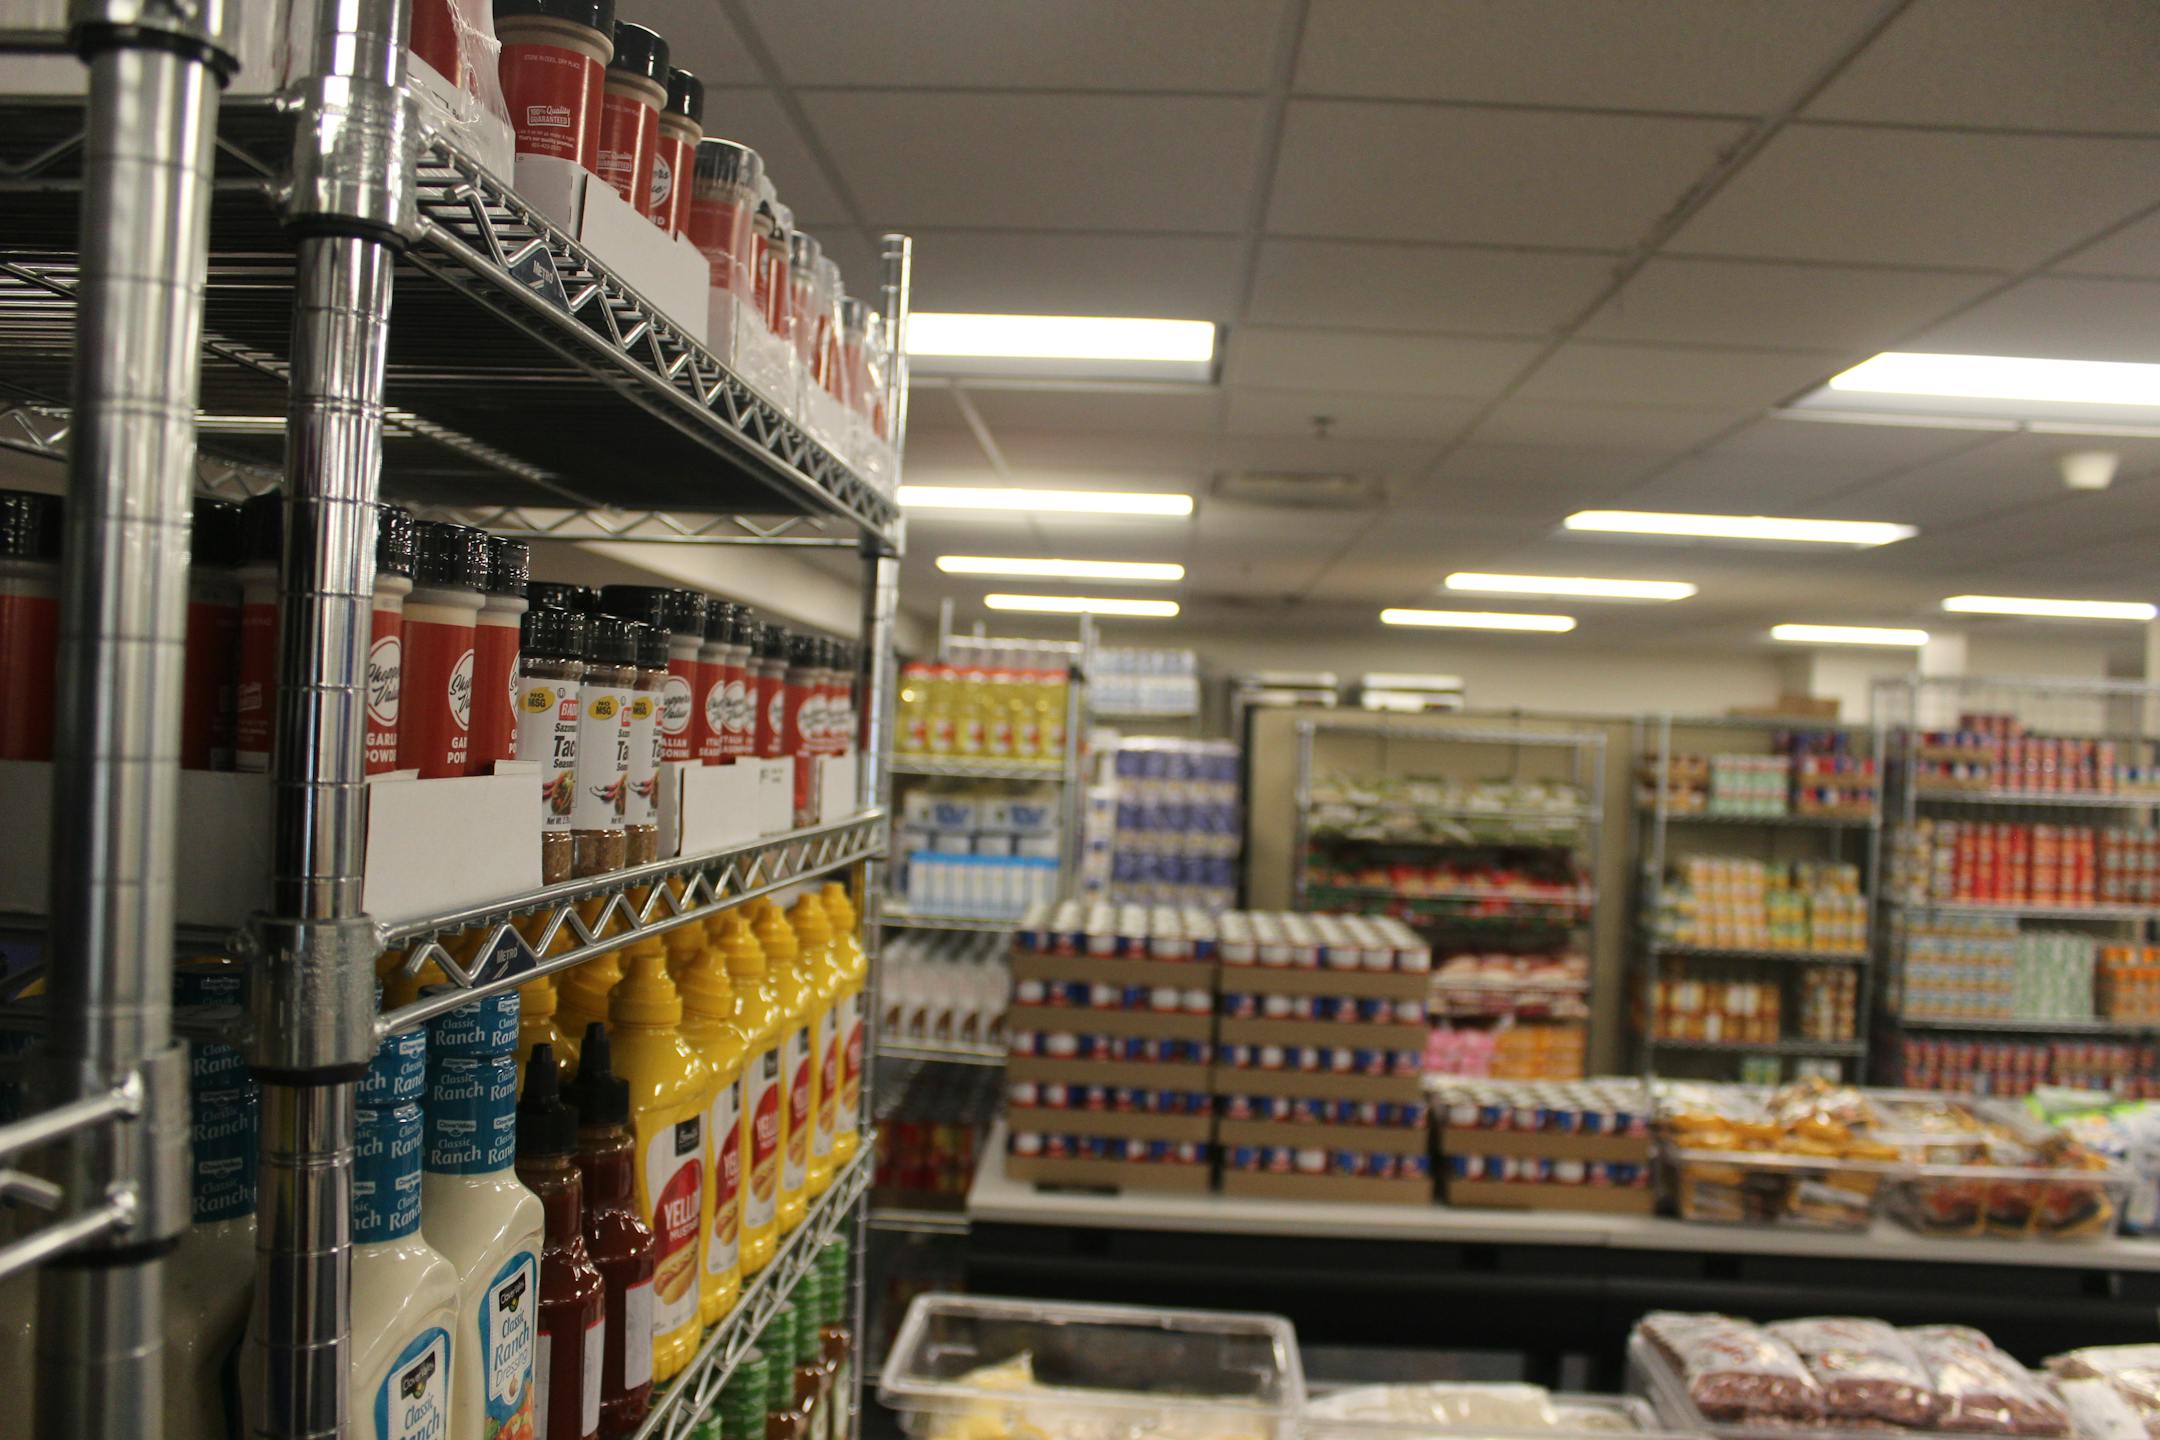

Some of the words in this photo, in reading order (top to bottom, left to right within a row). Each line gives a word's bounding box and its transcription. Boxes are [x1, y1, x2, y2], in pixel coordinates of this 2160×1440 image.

[530, 116, 568, 125] GUARANTEED
[546, 106, 570, 115] Quality
[532, 260, 554, 284] METRO
[528, 696, 546, 708] MSG
[596, 704, 612, 715] MSG
[496, 946, 518, 964] METRO
[442, 1018, 475, 1030] Classic
[436, 1026, 485, 1046] Ranch
[194, 1056, 244, 1076] Ranc
[440, 1072, 474, 1084] Classic
[434, 1080, 484, 1100] Ranch
[438, 1138, 471, 1149] Classic
[432, 1144, 482, 1164] Ranch
[502, 1309, 524, 1338] Classic
[494, 1320, 529, 1372] Ranch
[496, 1348, 528, 1388] Dressing
[404, 1392, 434, 1430] Classic
